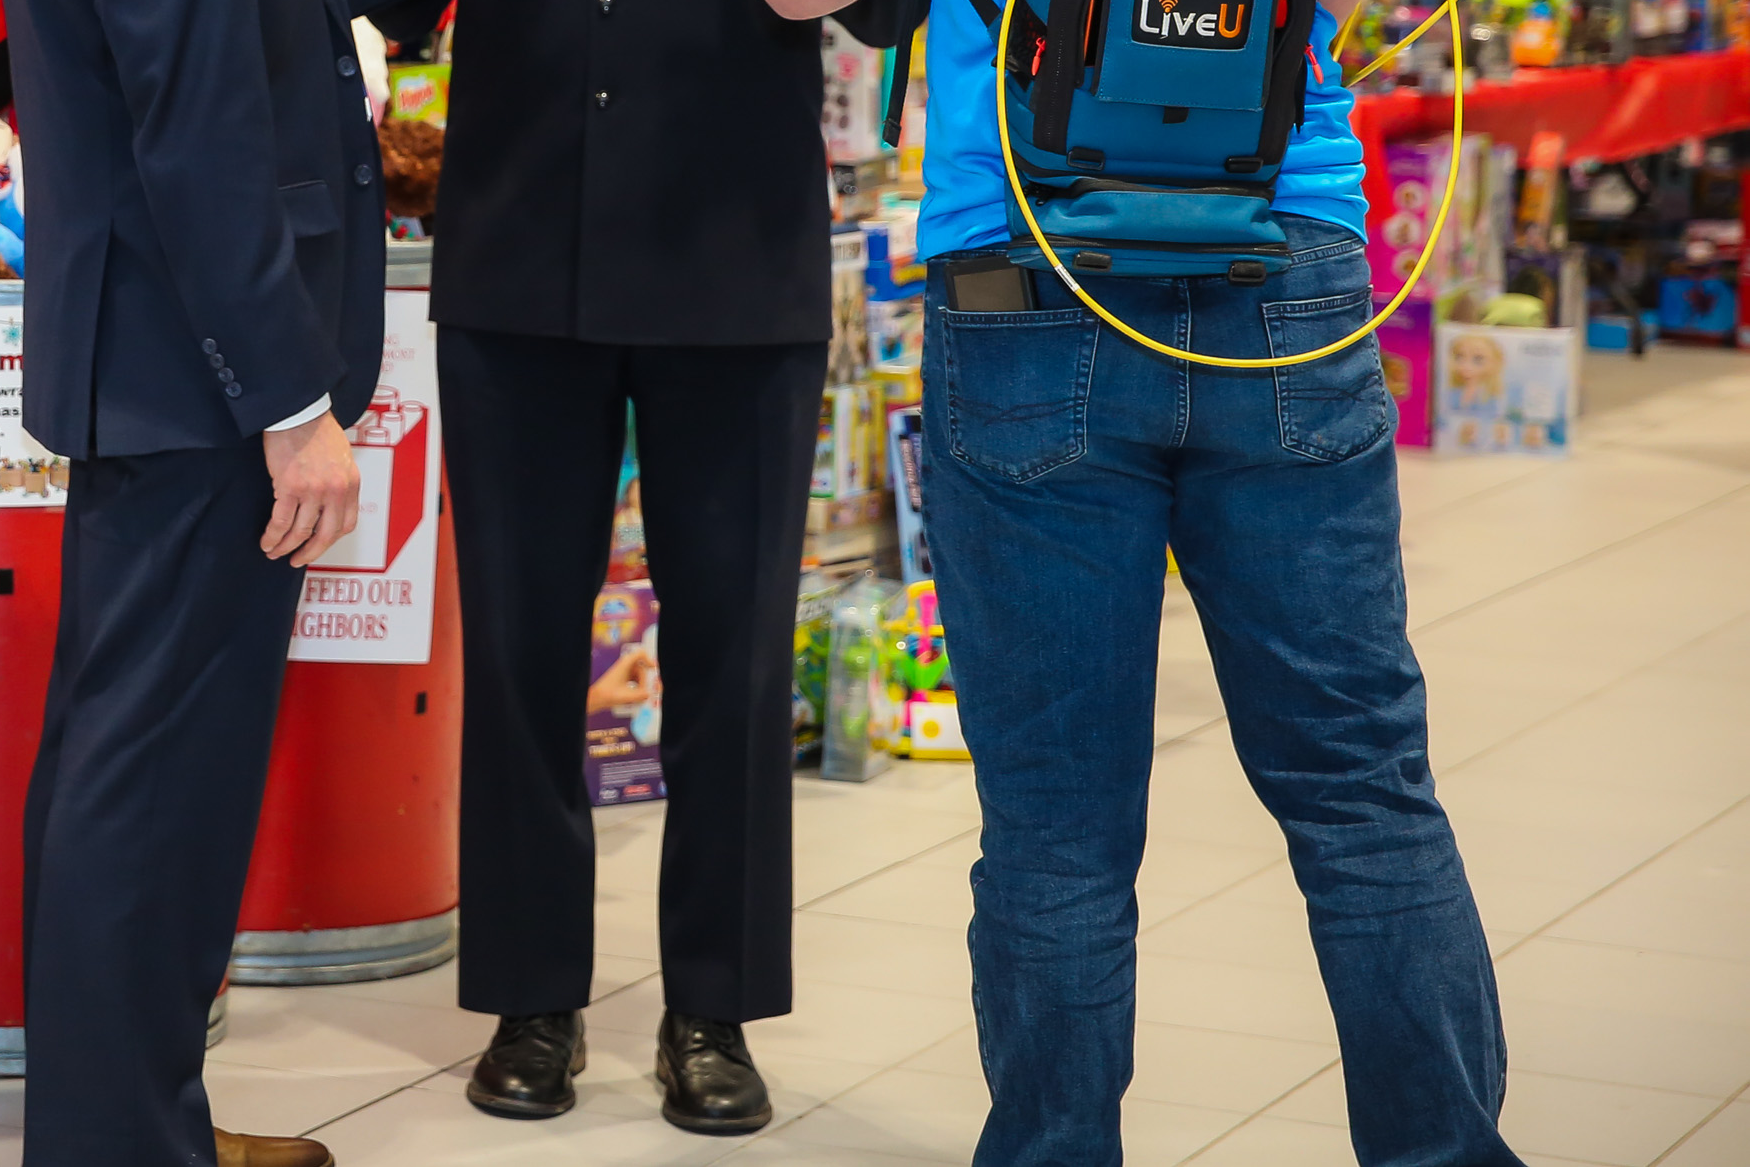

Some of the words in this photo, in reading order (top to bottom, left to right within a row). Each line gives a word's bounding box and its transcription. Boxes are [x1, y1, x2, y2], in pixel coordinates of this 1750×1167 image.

[305, 577, 364, 605] FEED
[368, 579, 412, 606] OUR
[291, 611, 388, 641] IGHBORS
